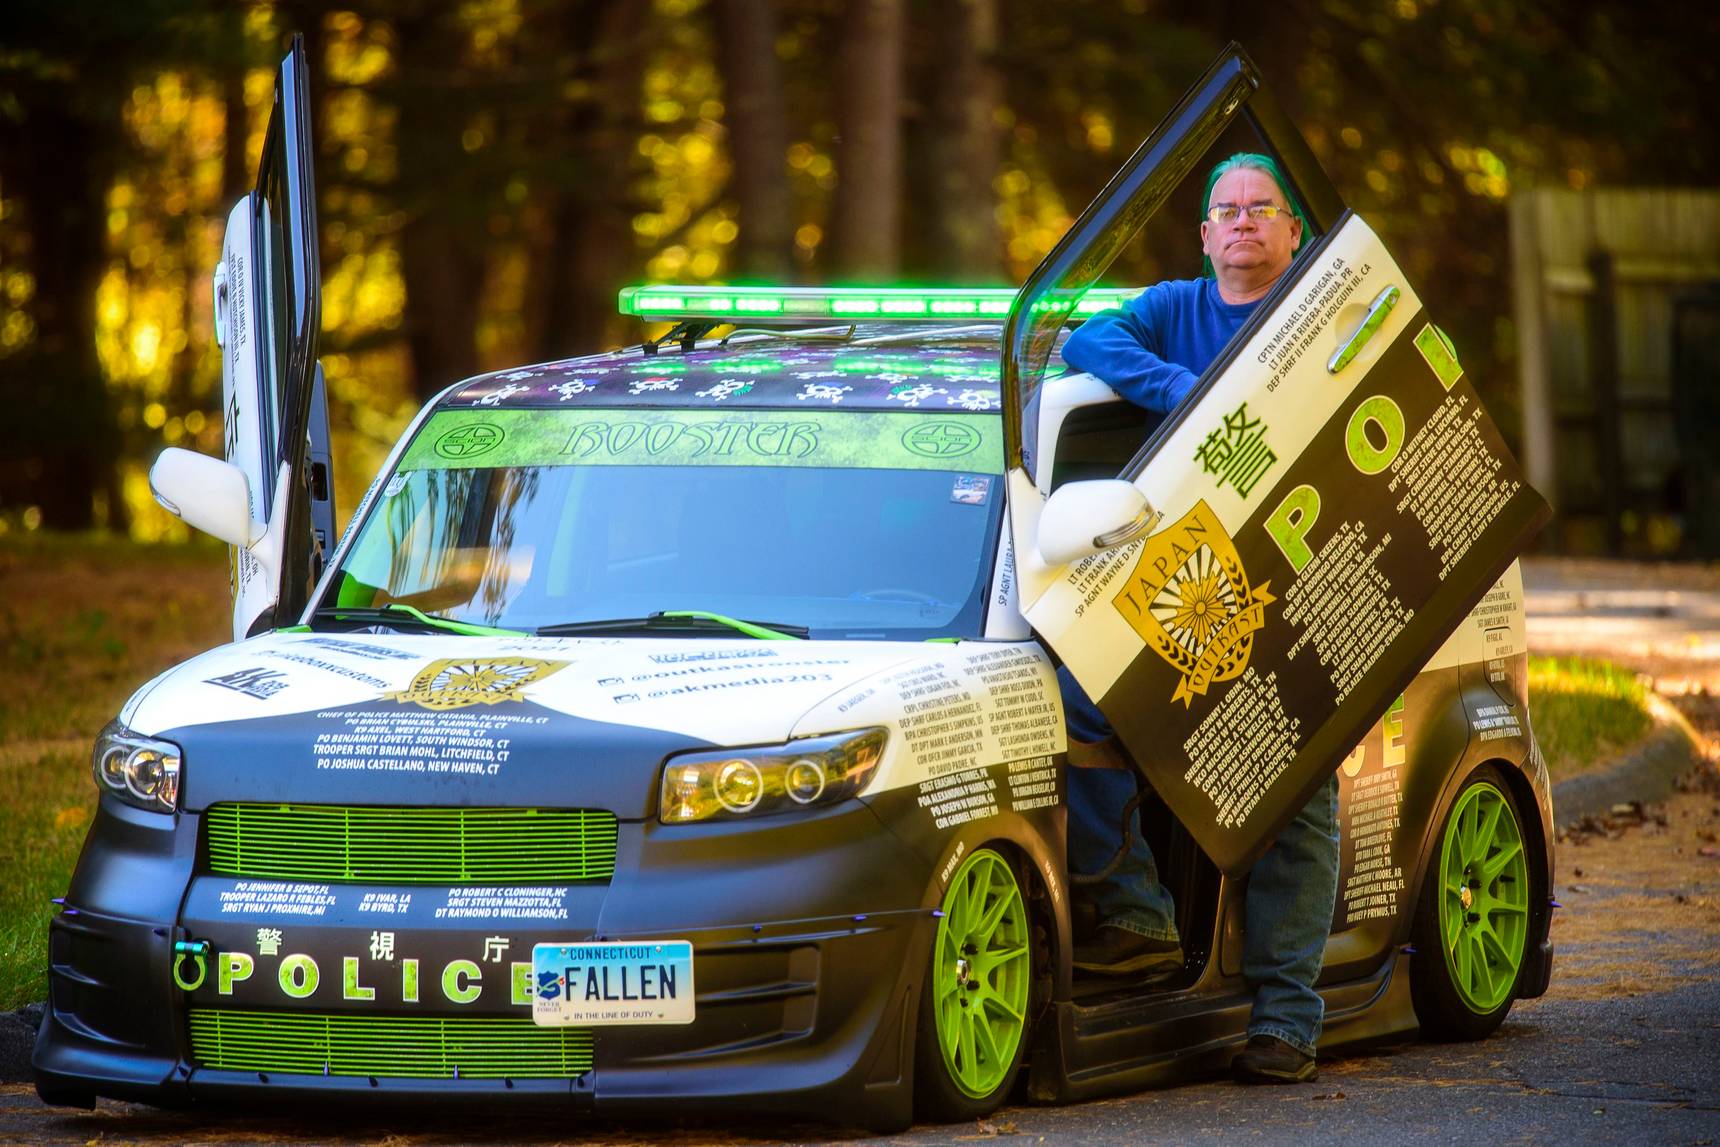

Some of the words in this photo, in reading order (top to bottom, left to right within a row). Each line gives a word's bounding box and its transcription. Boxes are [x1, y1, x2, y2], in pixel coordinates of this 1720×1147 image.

[1256, 342, 1276, 364] CPTN
[1272, 308, 1303, 344] MICHAEL
[1298, 302, 1307, 312] D
[1304, 267, 1335, 305] GARIGAN,
[1332, 256, 1344, 270] GA
[1266, 374, 1281, 392] DEP
[1278, 354, 1297, 377] SHRF
[1294, 349, 1301, 357] II
[1300, 324, 1322, 350] FRANK
[1320, 317, 1327, 326] G
[1324, 284, 1353, 320] HOLGUIN
[1350, 273, 1362, 287] III,
[1360, 262, 1371, 276] CA
[1268, 358, 1279, 370] LT
[1275, 339, 1294, 362] JUAN
[1291, 332, 1299, 342] R
[1296, 278, 1343, 335] RIVERA-PADUA,
[1340, 266, 1352, 280] PR
[558, 421, 822, 458] ROOSTER
[1193, 401, 1278, 500] 警
[1404, 465, 1422, 488] SRGT
[1419, 446, 1438, 470] STEVE
[1436, 426, 1455, 450] URIAS,
[1453, 416, 1463, 429] TX
[1442, 534, 1452, 547] PO
[1450, 512, 1470, 537] SHANE
[1468, 489, 1488, 515] GREEN,
[1487, 479, 1497, 492] AR
[1074, 603, 1086, 617] SP
[1082, 583, 1103, 607] AGNT
[1099, 557, 1124, 587] WAYNE
[1120, 550, 1130, 560] D
[1077, 582, 1088, 594] LT
[1085, 557, 1108, 584] FRANK
[1124, 515, 1211, 616] JAPAN
[1302, 612, 1313, 626] PO
[1311, 586, 1334, 616] BONNIE
[1331, 579, 1340, 591] N
[1337, 560, 1356, 584] JONES,
[1355, 549, 1365, 562] VA
[1311, 624, 1328, 646] SRGT
[1326, 596, 1352, 628] STEPHEN
[1349, 575, 1369, 600] JONES,
[1368, 564, 1378, 578] SC
[1193, 605, 1262, 687] OUTKAST
[1334, 692, 1345, 706] PO
[1342, 669, 1364, 696] BLAIZE
[1360, 620, 1404, 674] MADRID-EVANS,
[1402, 607, 1415, 624] MO
[648, 673, 832, 698] @akmedia203
[438, 720, 492, 728] PLAINVILLE,
[479, 714, 534, 724] PLAINVILLE,
[1182, 728, 1202, 752] SRGT
[1198, 704, 1222, 733] SONNY
[1219, 699, 1226, 709] L
[1224, 679, 1243, 703] OBIN,
[1242, 666, 1255, 682] MO
[1188, 747, 1199, 761] PO
[1197, 726, 1217, 750] RICKY
[1215, 718, 1223, 729] N
[1221, 685, 1251, 722] ROBERTS,
[1250, 673, 1261, 687] TX
[317, 734, 330, 742] PO
[331, 734, 378, 743] BENJAMIN
[380, 735, 414, 745] LOVETT,
[416, 736, 447, 745] SOUTH
[448, 737, 495, 749] WINDSOR,
[497, 740, 510, 748] CT
[420, 728, 470, 736] HARTFORD,
[313, 744, 354, 754] TROOPER
[354, 744, 378, 755] SRGT
[380, 745, 409, 756] BRIAN
[410, 746, 439, 758] MOHL,
[441, 748, 496, 762] LITCHFIELD,
[497, 750, 510, 761] CT
[318, 759, 330, 768] PO
[331, 759, 366, 770] JOSHUA
[367, 760, 426, 772] CASTELLANO,
[428, 761, 450, 772] NEW
[451, 762, 486, 775] HAVEN,
[488, 764, 500, 774] CT
[220, 892, 256, 902] TROOPER
[256, 893, 289, 902] LAZARO
[235, 882, 247, 891] PO
[247, 883, 286, 892] JENNIFER
[364, 894, 375, 902] K9
[376, 894, 398, 904] IVAR,
[400, 894, 411, 903] LA
[448, 888, 460, 897] PO
[462, 888, 496, 897] ROBERT
[497, 888, 504, 897] C
[448, 898, 471, 906] SRGT
[471, 898, 502, 907] STEVEN
[222, 902, 244, 912] SRGT
[243, 903, 265, 913] RYAN
[358, 902, 370, 912] K9
[370, 903, 395, 914] BYRD,
[398, 904, 408, 912] TX
[435, 908, 447, 918] DT
[448, 908, 491, 918] RAYMOND
[492, 908, 498, 918] O
[570, 947, 651, 960] CONNECTICUT
[218, 951, 534, 1005] POLICE
[565, 964, 676, 1001] FALLEN
